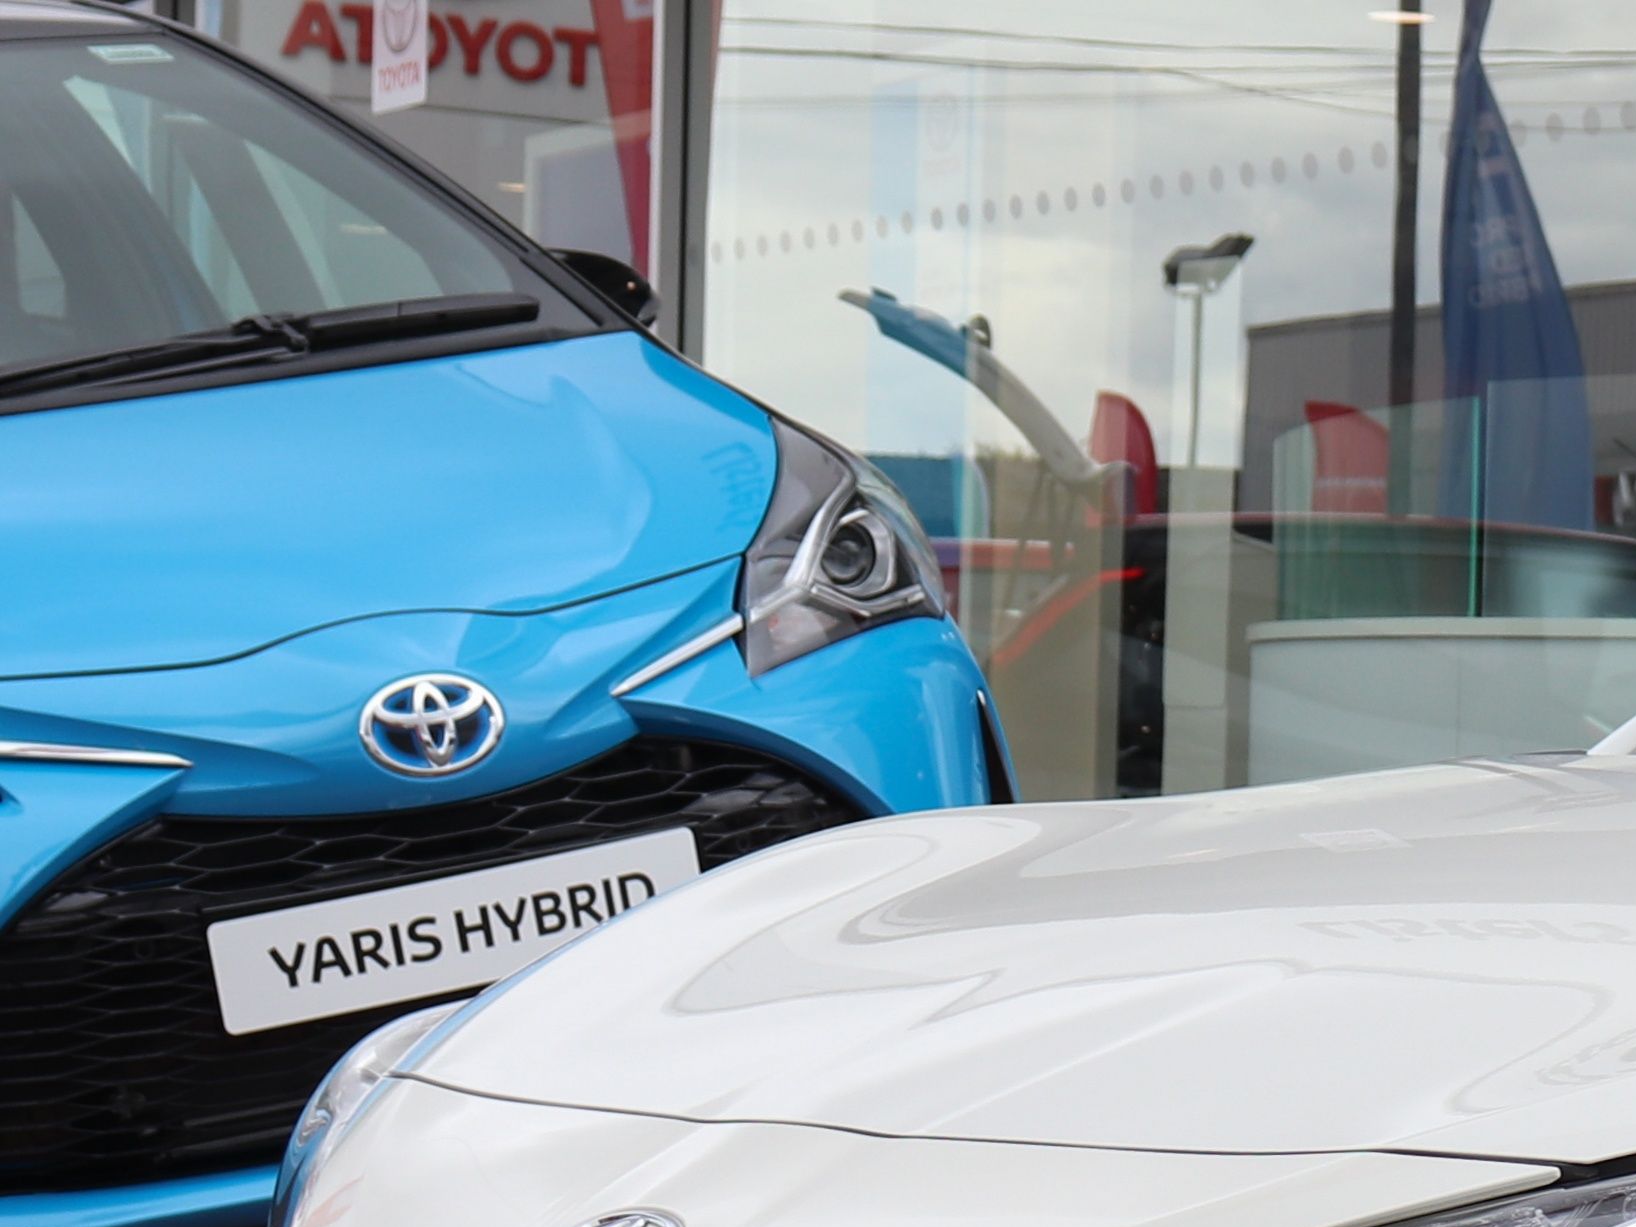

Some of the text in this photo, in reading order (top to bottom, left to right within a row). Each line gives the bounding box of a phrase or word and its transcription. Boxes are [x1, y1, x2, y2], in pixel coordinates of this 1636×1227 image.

[378, 61, 420, 91] TOYOTA
[268, 871, 656, 988] YARIS HYBRID
